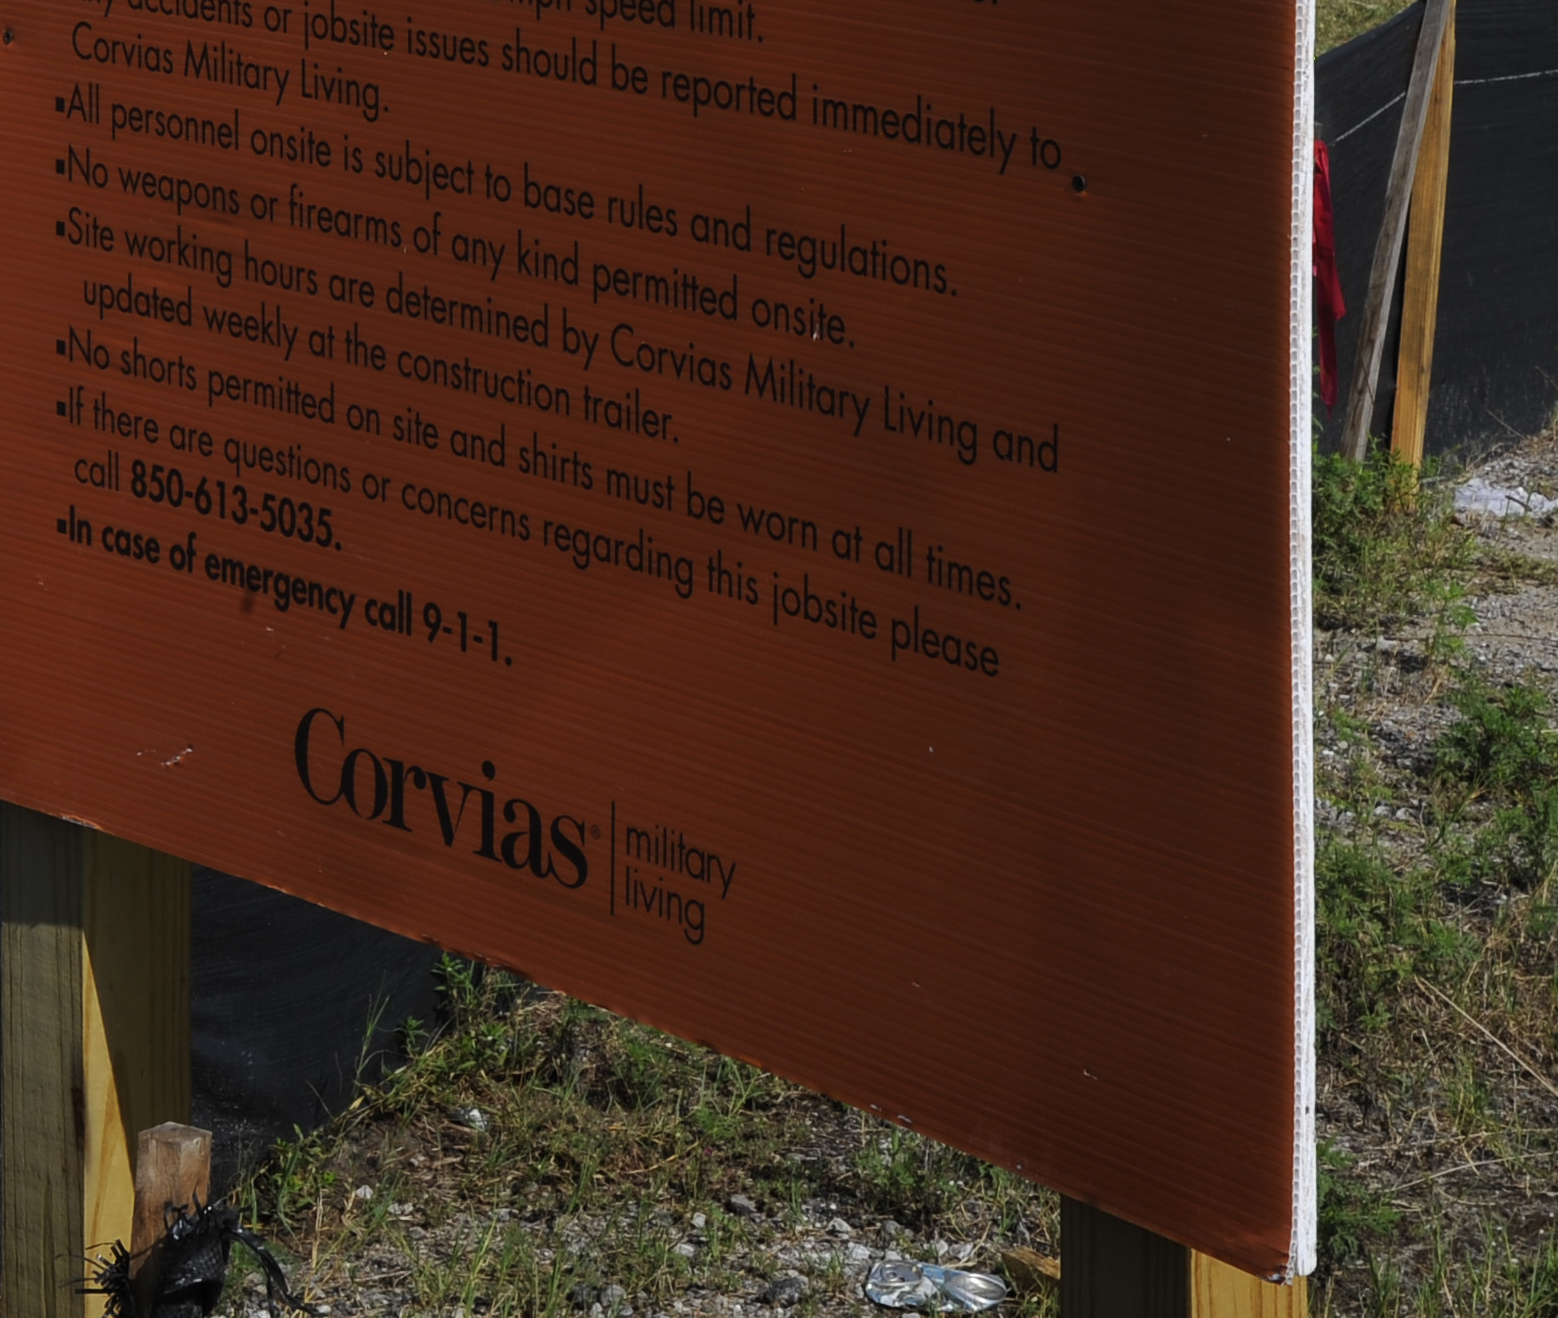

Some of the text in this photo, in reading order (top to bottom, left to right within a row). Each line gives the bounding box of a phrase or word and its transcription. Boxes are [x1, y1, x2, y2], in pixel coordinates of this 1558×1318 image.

[72, 21, 388, 122] Corvias Military Living.
[264, 6, 292, 33] or
[407, 17, 489, 67] issues
[502, 28, 597, 85] should
[612, 43, 648, 94] be
[662, 72, 796, 121] reported
[813, 84, 1017, 174] immediately
[1030, 127, 1061, 170] to
[67, 83, 957, 296] All personnel onsite is subject to base rules and regulations.
[68, 146, 854, 347] No weapons or firearms of any kind permitted onsite.
[68, 207, 1058, 473] Site working hours are determined by Corvias Military Living and
[84, 274, 678, 443] updated weekly at the construction trailer.
[69, 327, 1021, 610] No shorts permitted on site and shirts must be worn at all times.
[69, 386, 999, 677] If there are questions or concerns regarding this jobsite please
[75, 451, 341, 551] call 850-613-5035.
[69, 505, 512, 666] In case of emergency call 9-1-1.
[294, 708, 737, 900] Corvias military
[626, 866, 705, 945] living
